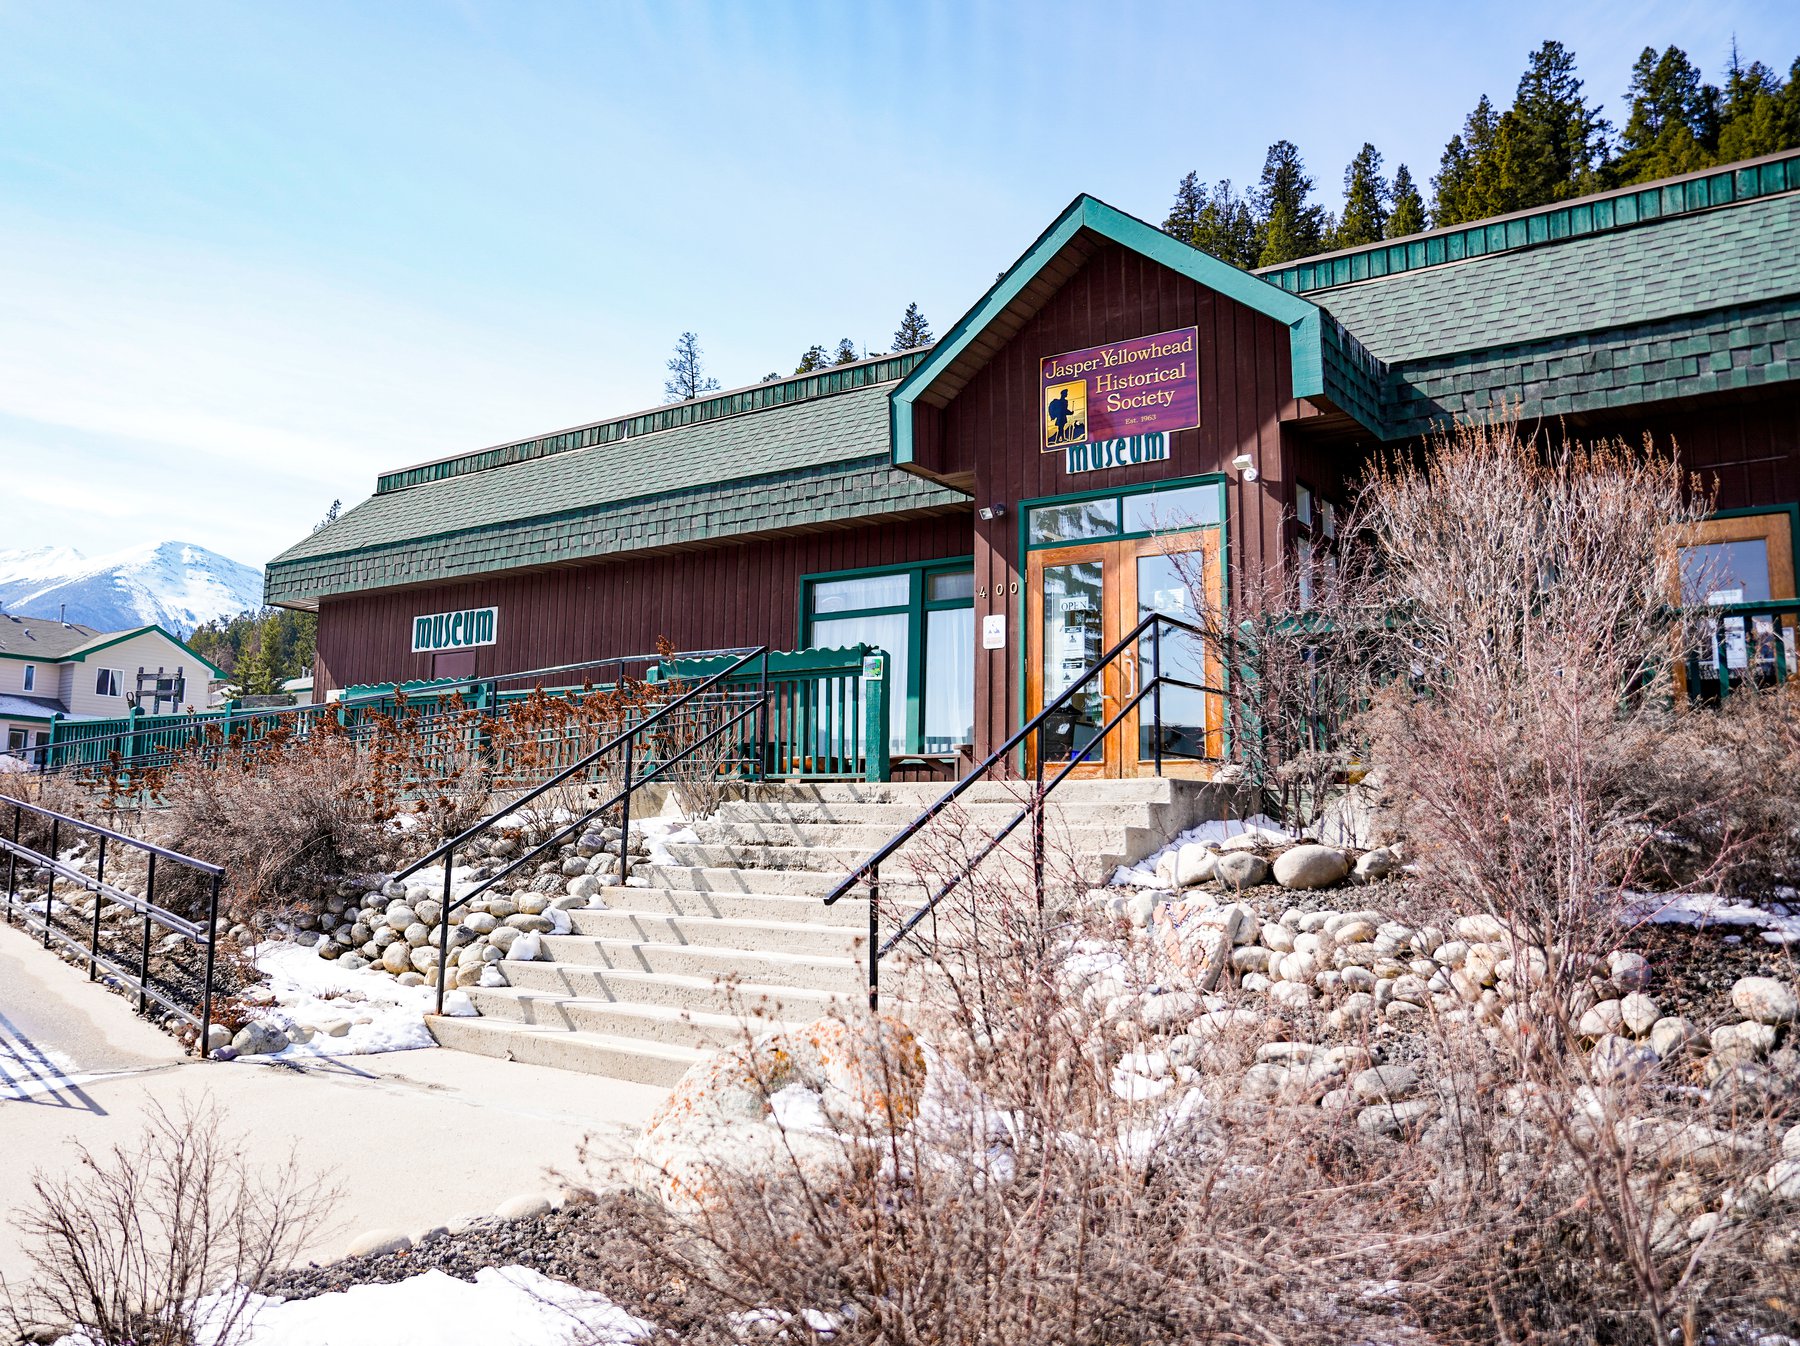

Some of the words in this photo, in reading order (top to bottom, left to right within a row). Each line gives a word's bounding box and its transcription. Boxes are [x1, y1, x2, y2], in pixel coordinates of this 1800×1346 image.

[1045, 335, 1193, 379] Jasper-Yellowhead
[1095, 362, 1187, 394] Historical
[1106, 389, 1176, 413] Society
[1140, 414, 1157, 423] 1963
[1068, 431, 1165, 473] museum
[979, 582, 1019, 598] 400
[1060, 600, 1088, 611] OPEN
[414, 609, 494, 649] museum
